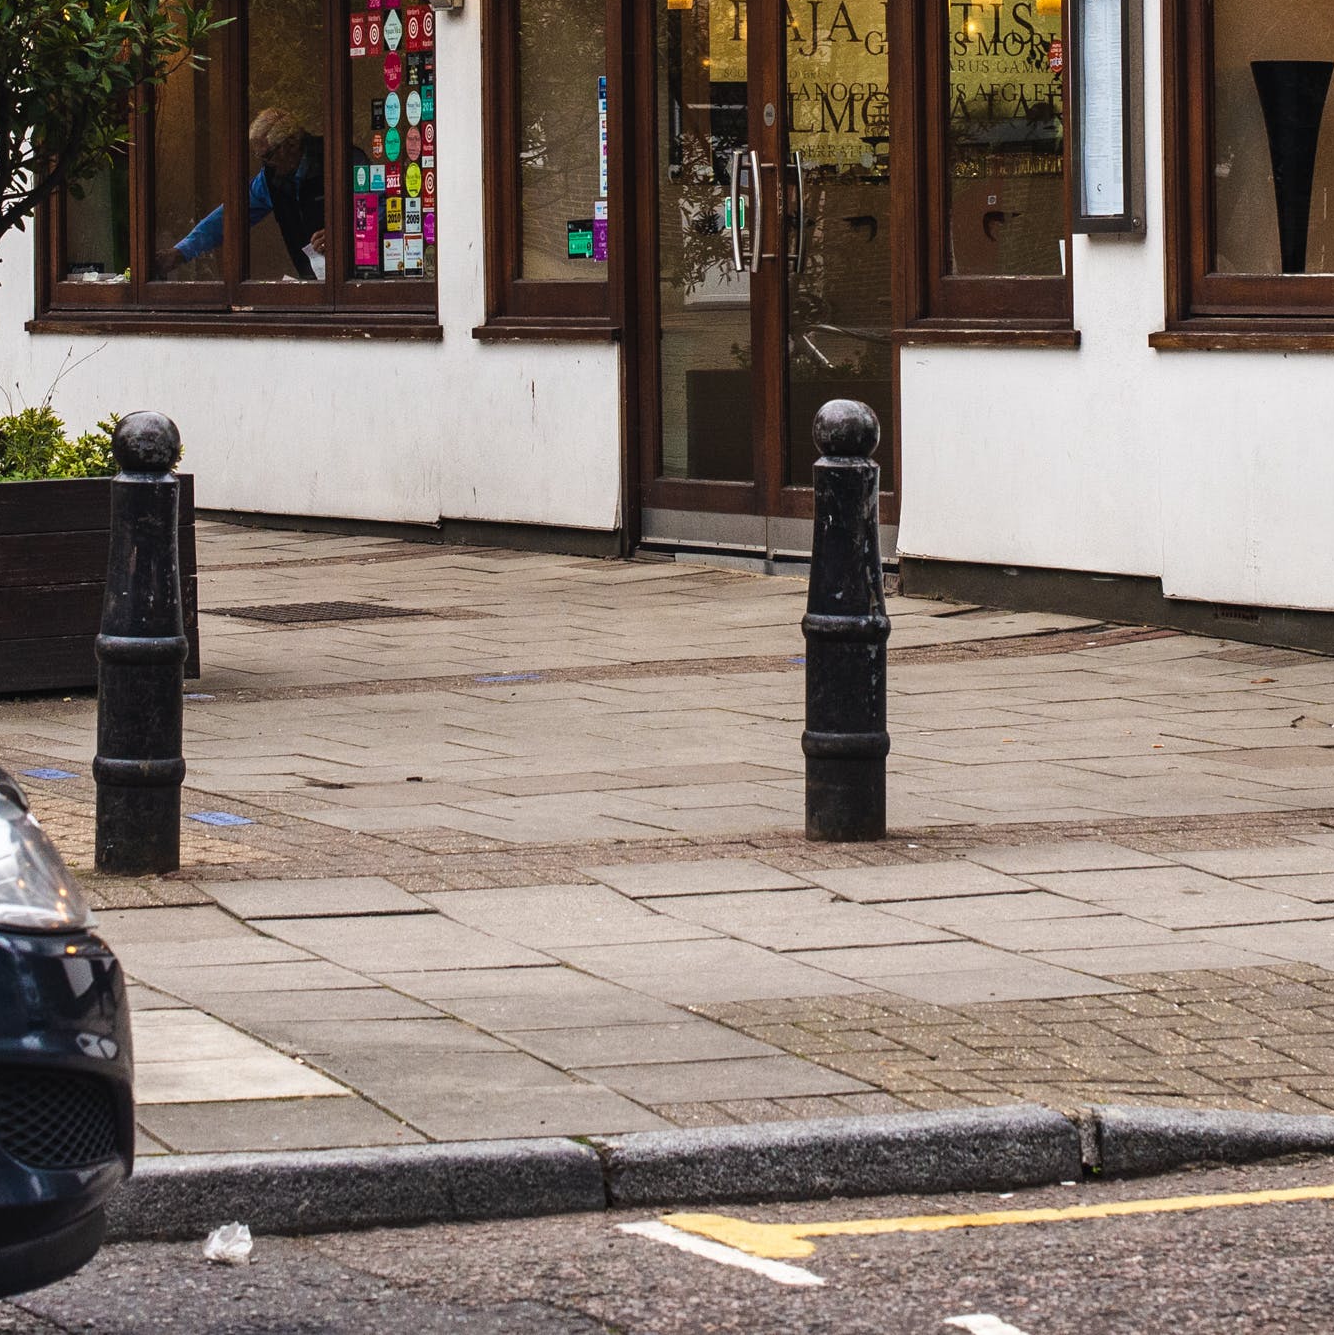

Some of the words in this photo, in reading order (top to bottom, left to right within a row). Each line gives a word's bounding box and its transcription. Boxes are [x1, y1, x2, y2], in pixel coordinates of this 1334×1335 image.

[386, 177, 401, 188] 2011
[387, 212, 401, 224] 2010
[406, 214, 420, 225] 2009
